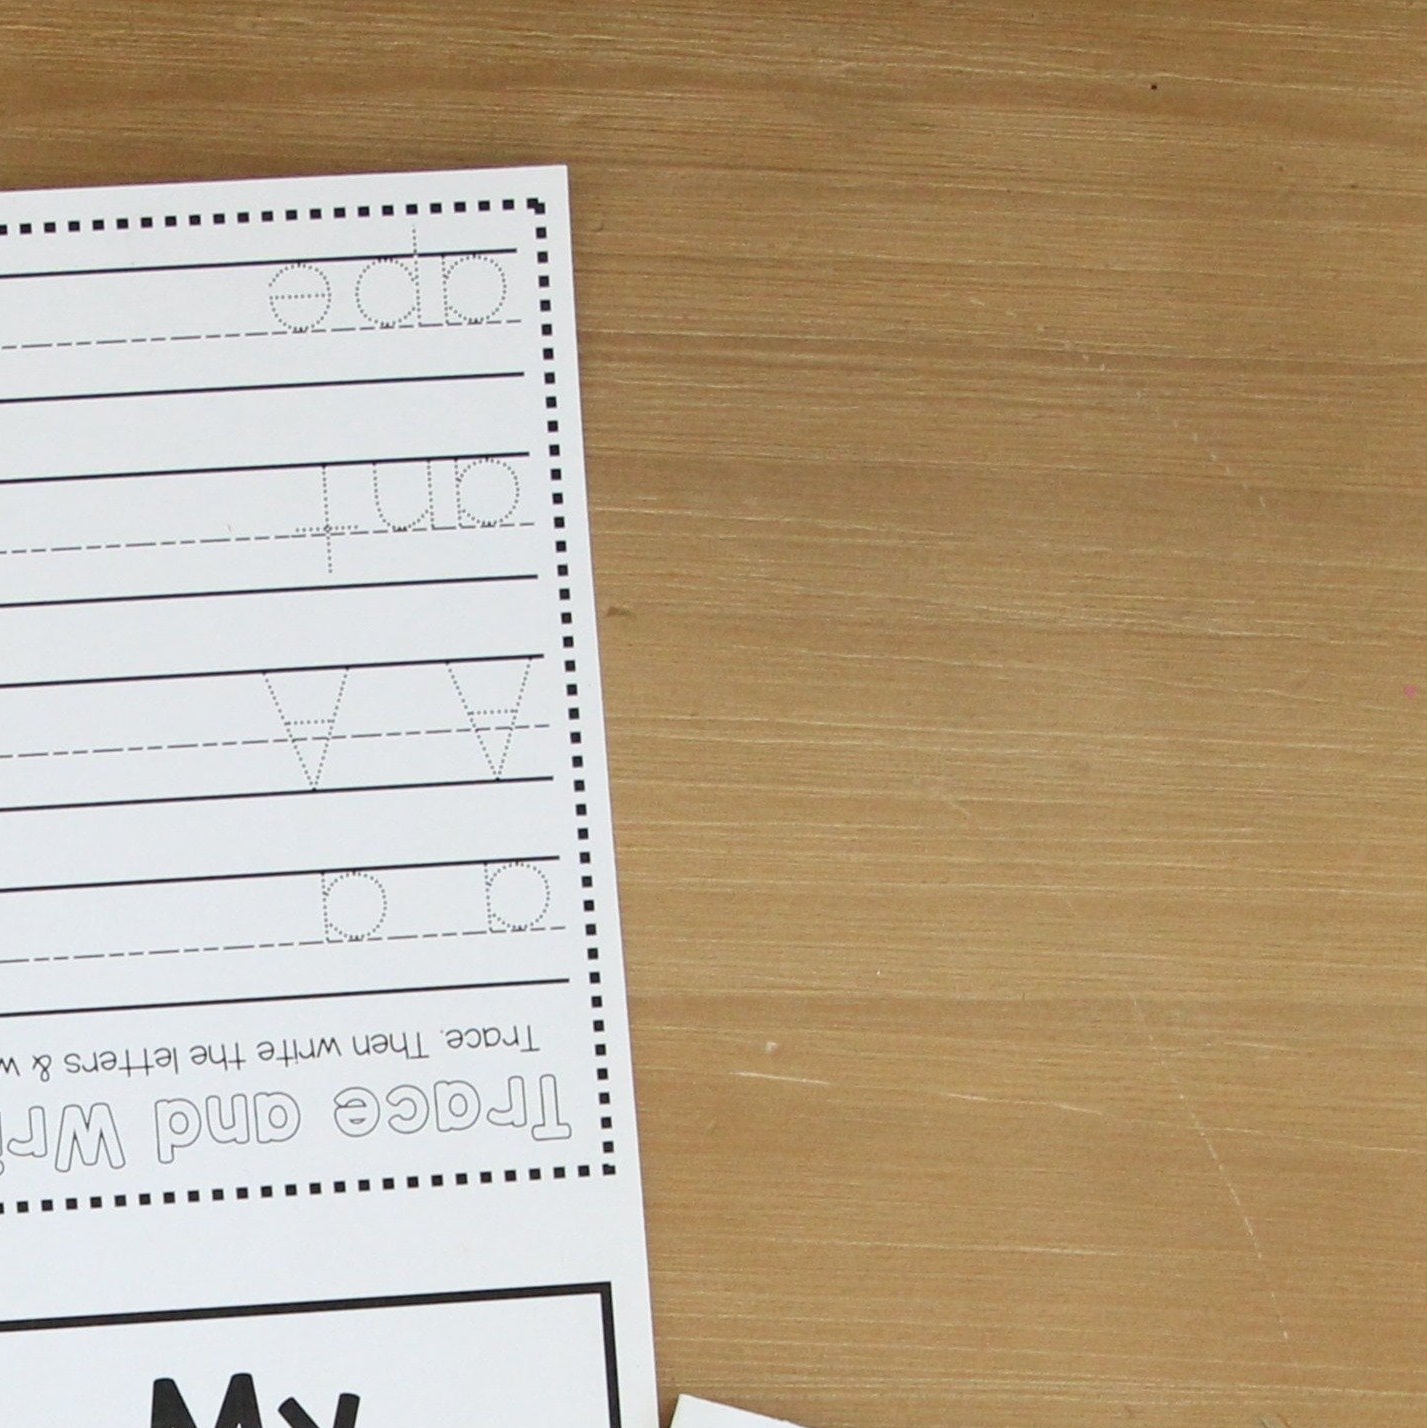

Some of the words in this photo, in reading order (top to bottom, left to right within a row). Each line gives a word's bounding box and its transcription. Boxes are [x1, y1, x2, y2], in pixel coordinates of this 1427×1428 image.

[268, 225, 507, 329] ape
[293, 456, 521, 574] ant
[261, 664, 351, 792] A
[444, 656, 534, 782] A
[320, 867, 388, 944] a
[482, 859, 551, 934] a
[32, 1053, 53, 1083] &
[64, 1046, 179, 1078] letters
[189, 1042, 247, 1072] the
[256, 1036, 343, 1068] write
[352, 1031, 430, 1060] Then
[440, 1024, 541, 1054] Trace.
[153, 1091, 302, 1165] and
[333, 1072, 573, 1143] Trace
